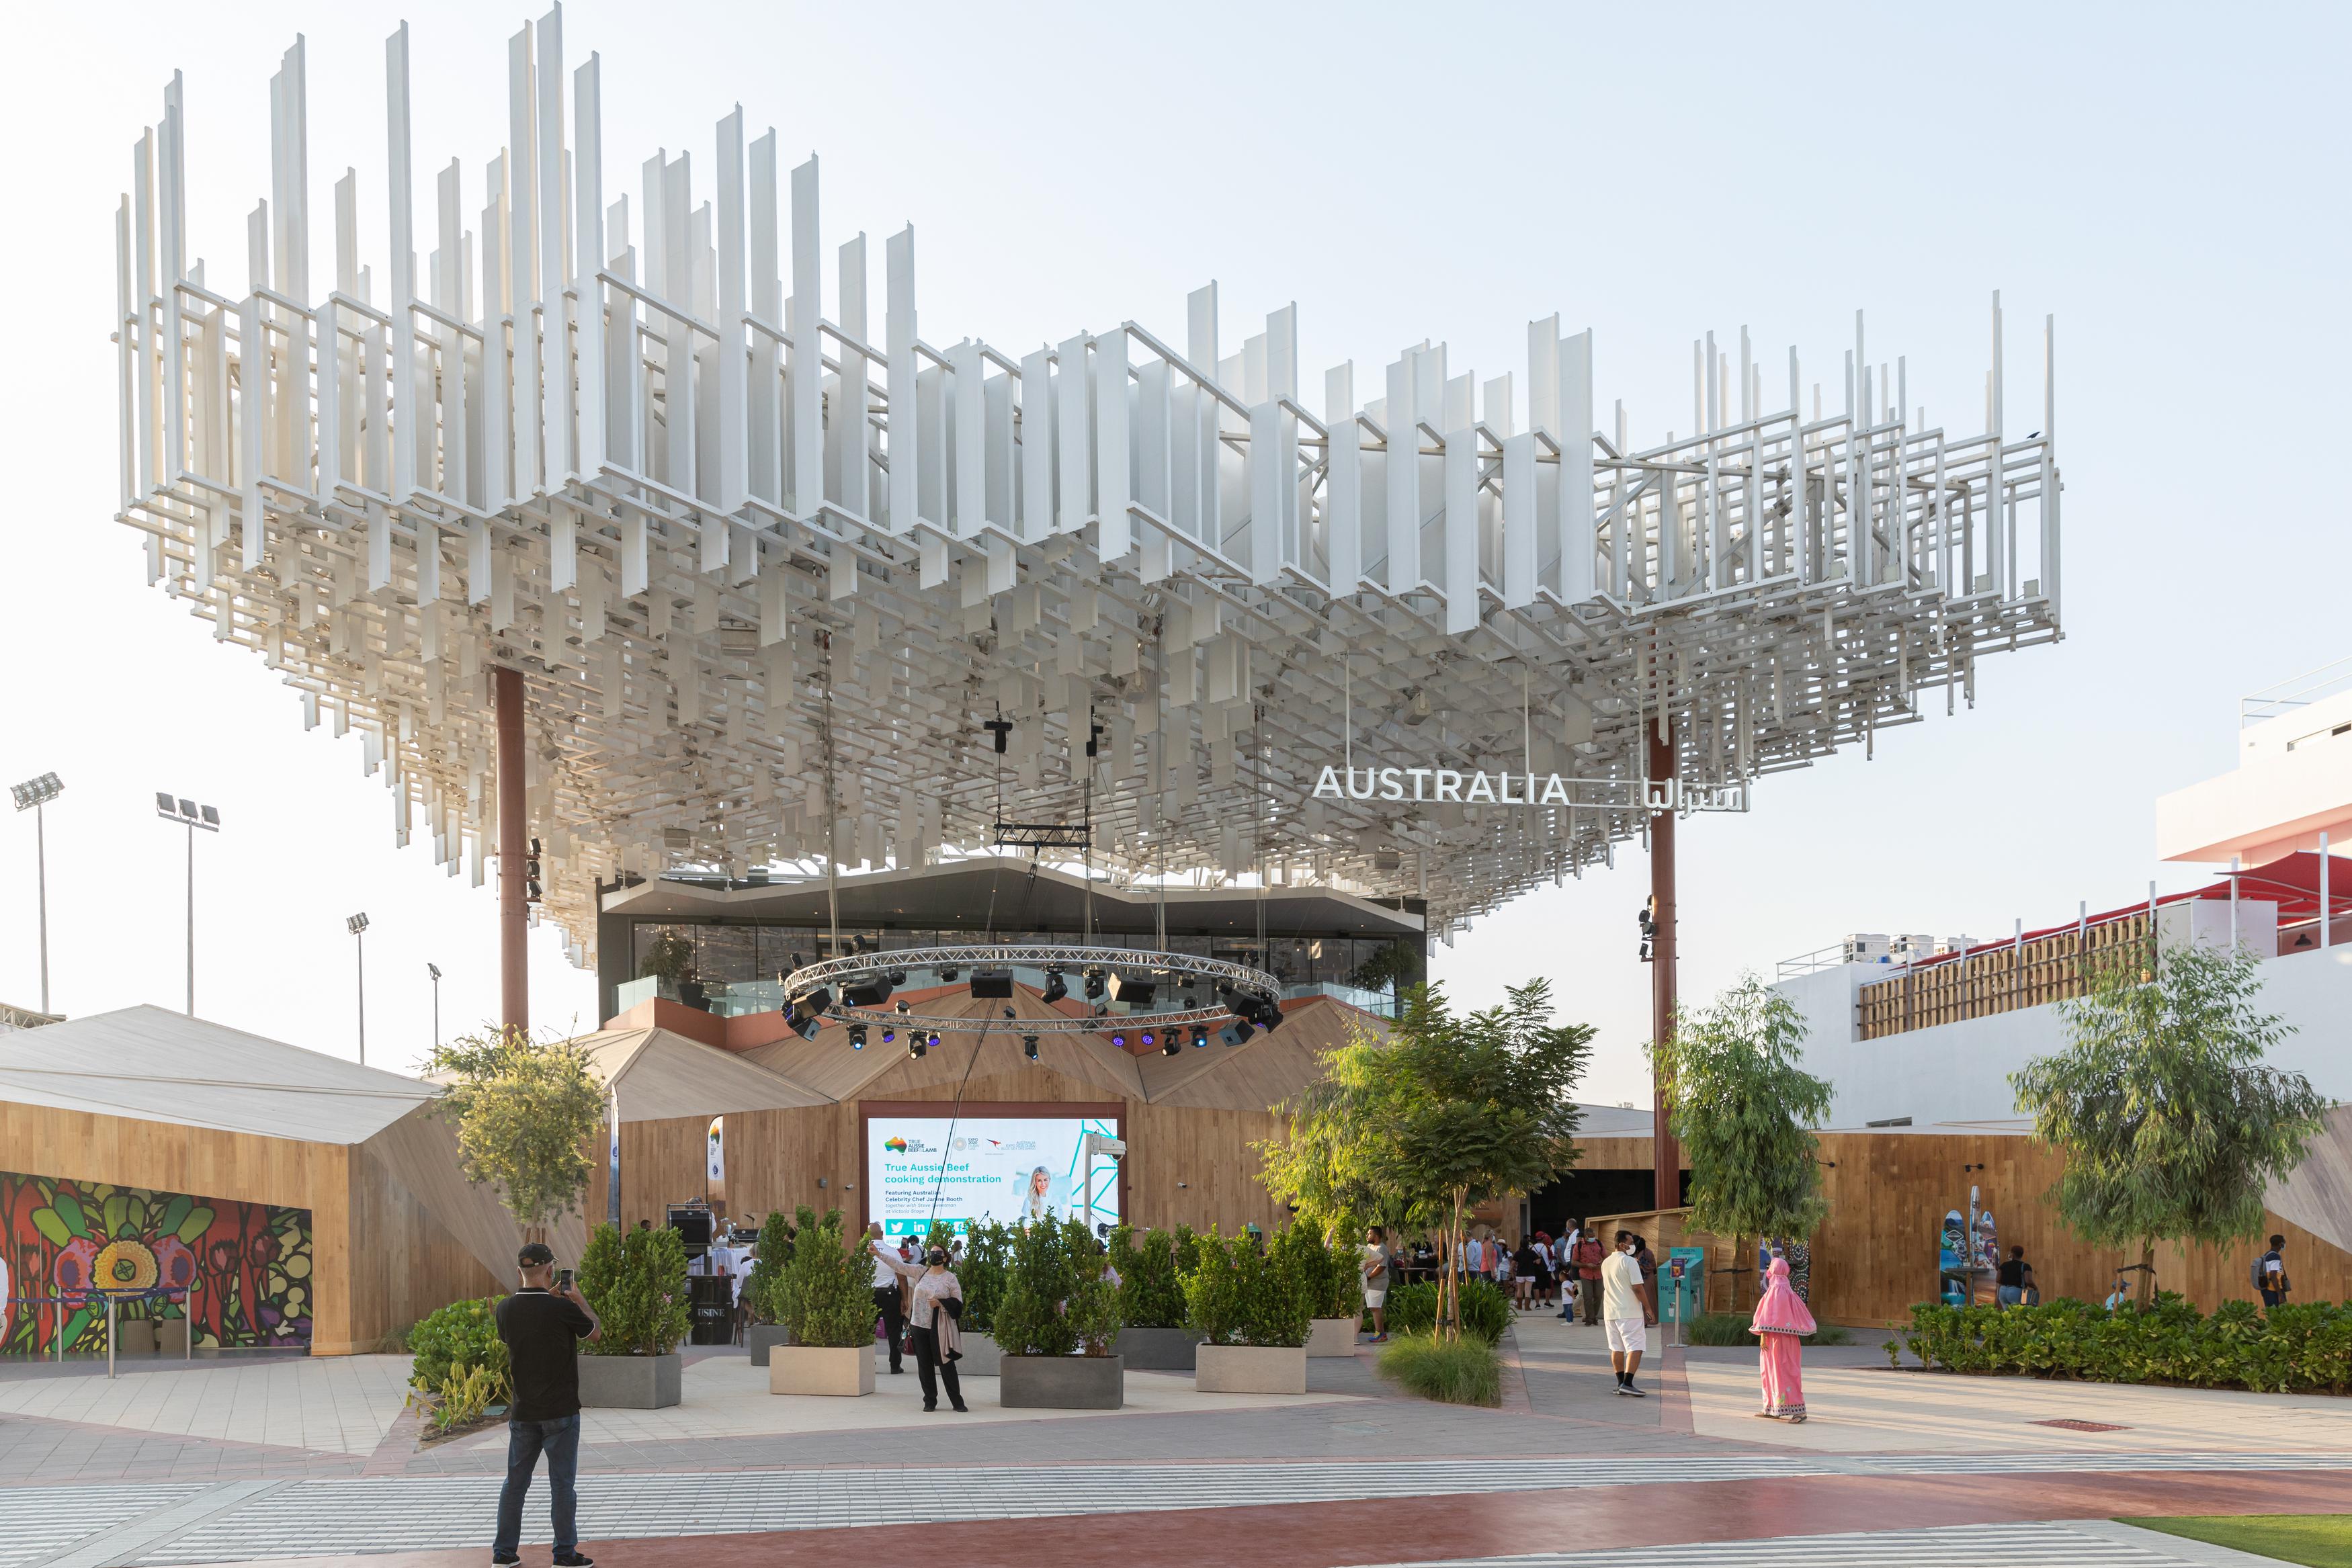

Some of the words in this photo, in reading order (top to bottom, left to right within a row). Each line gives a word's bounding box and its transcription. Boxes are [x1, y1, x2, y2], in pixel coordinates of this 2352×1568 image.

[1311, 765, 1570, 806] AUSTRALIA
[911, 1163, 943, 1171] Aussie
[947, 1163, 970, 1171] Beef
[885, 1175, 925, 1185] cooking
[928, 1174, 1001, 1183] demonstration
[698, 1308, 725, 1317] USINE
